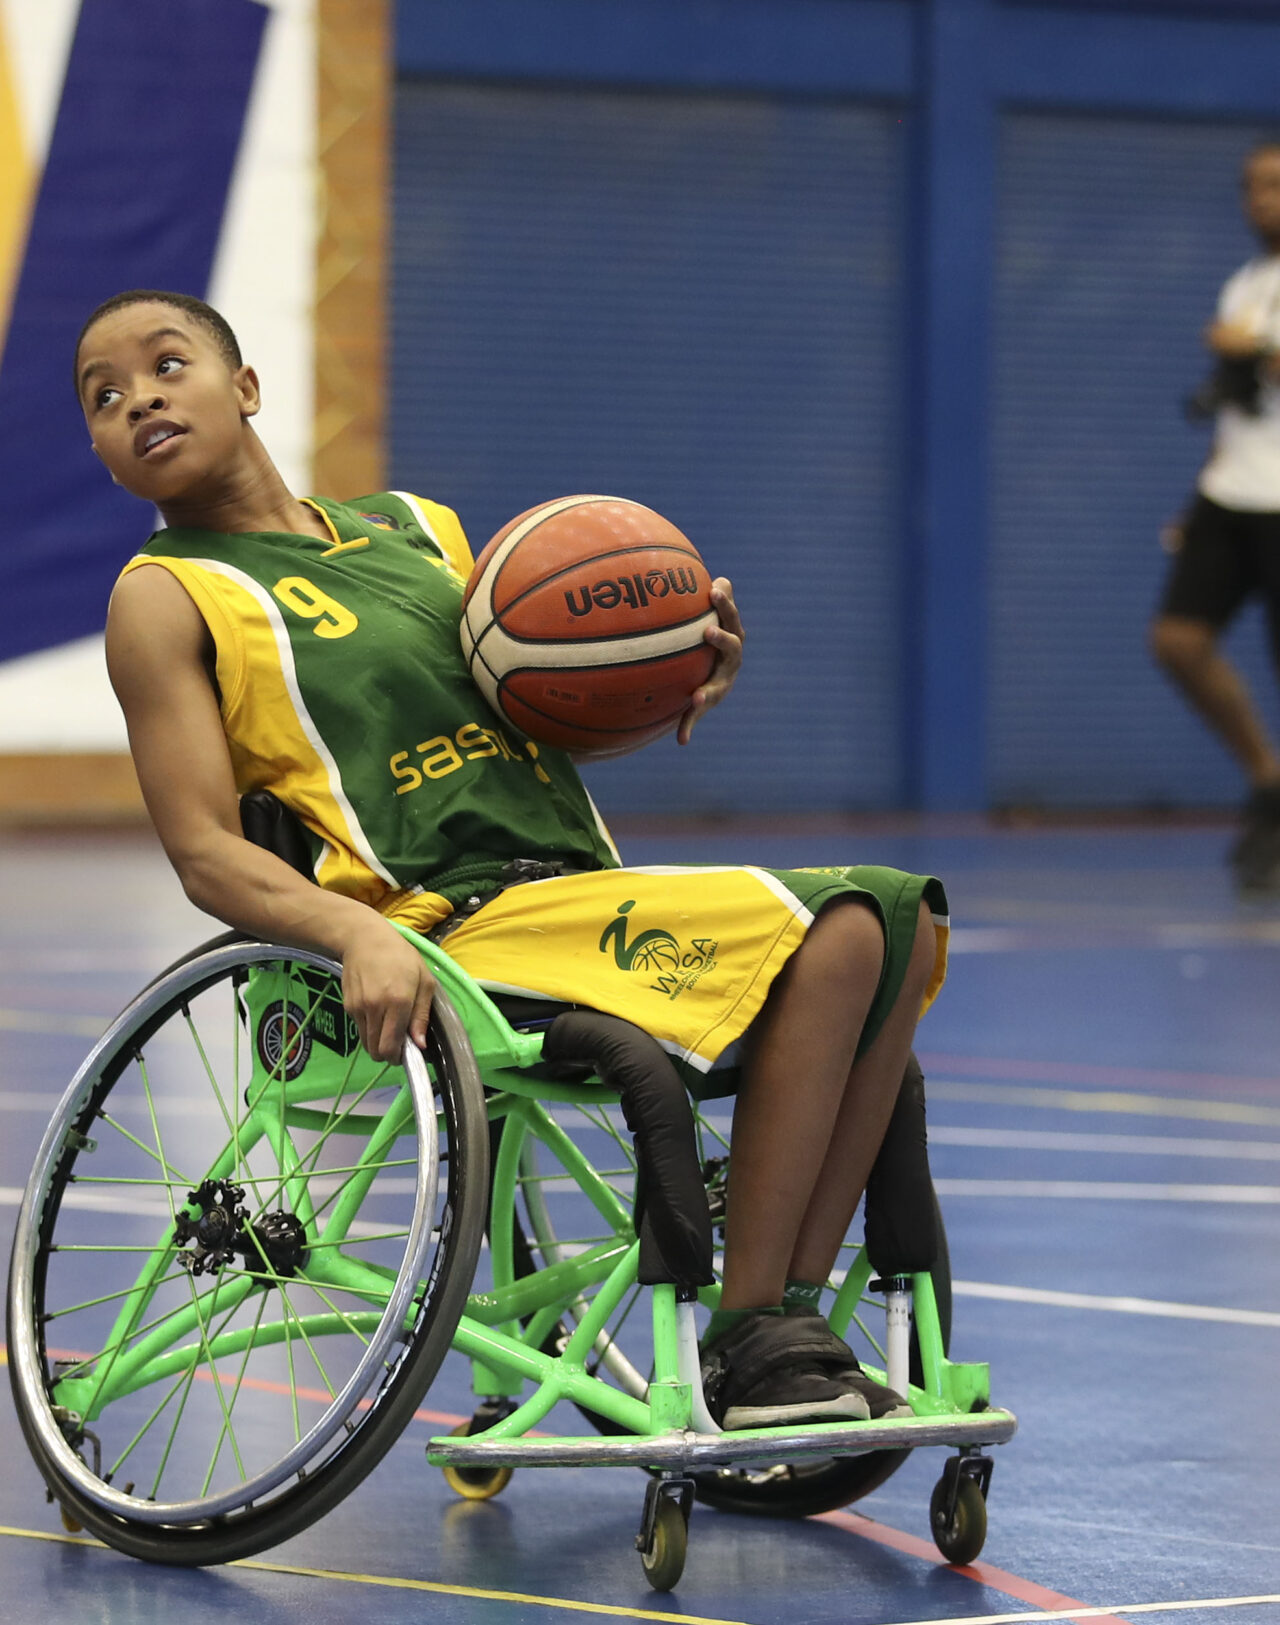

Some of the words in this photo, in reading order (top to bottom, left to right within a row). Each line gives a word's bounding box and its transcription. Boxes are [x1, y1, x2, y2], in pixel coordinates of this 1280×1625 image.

[271, 576, 359, 640] 9
[564, 567, 698, 617] molten
[389, 722, 551, 796] sas
[650, 938, 713, 995] WSA
